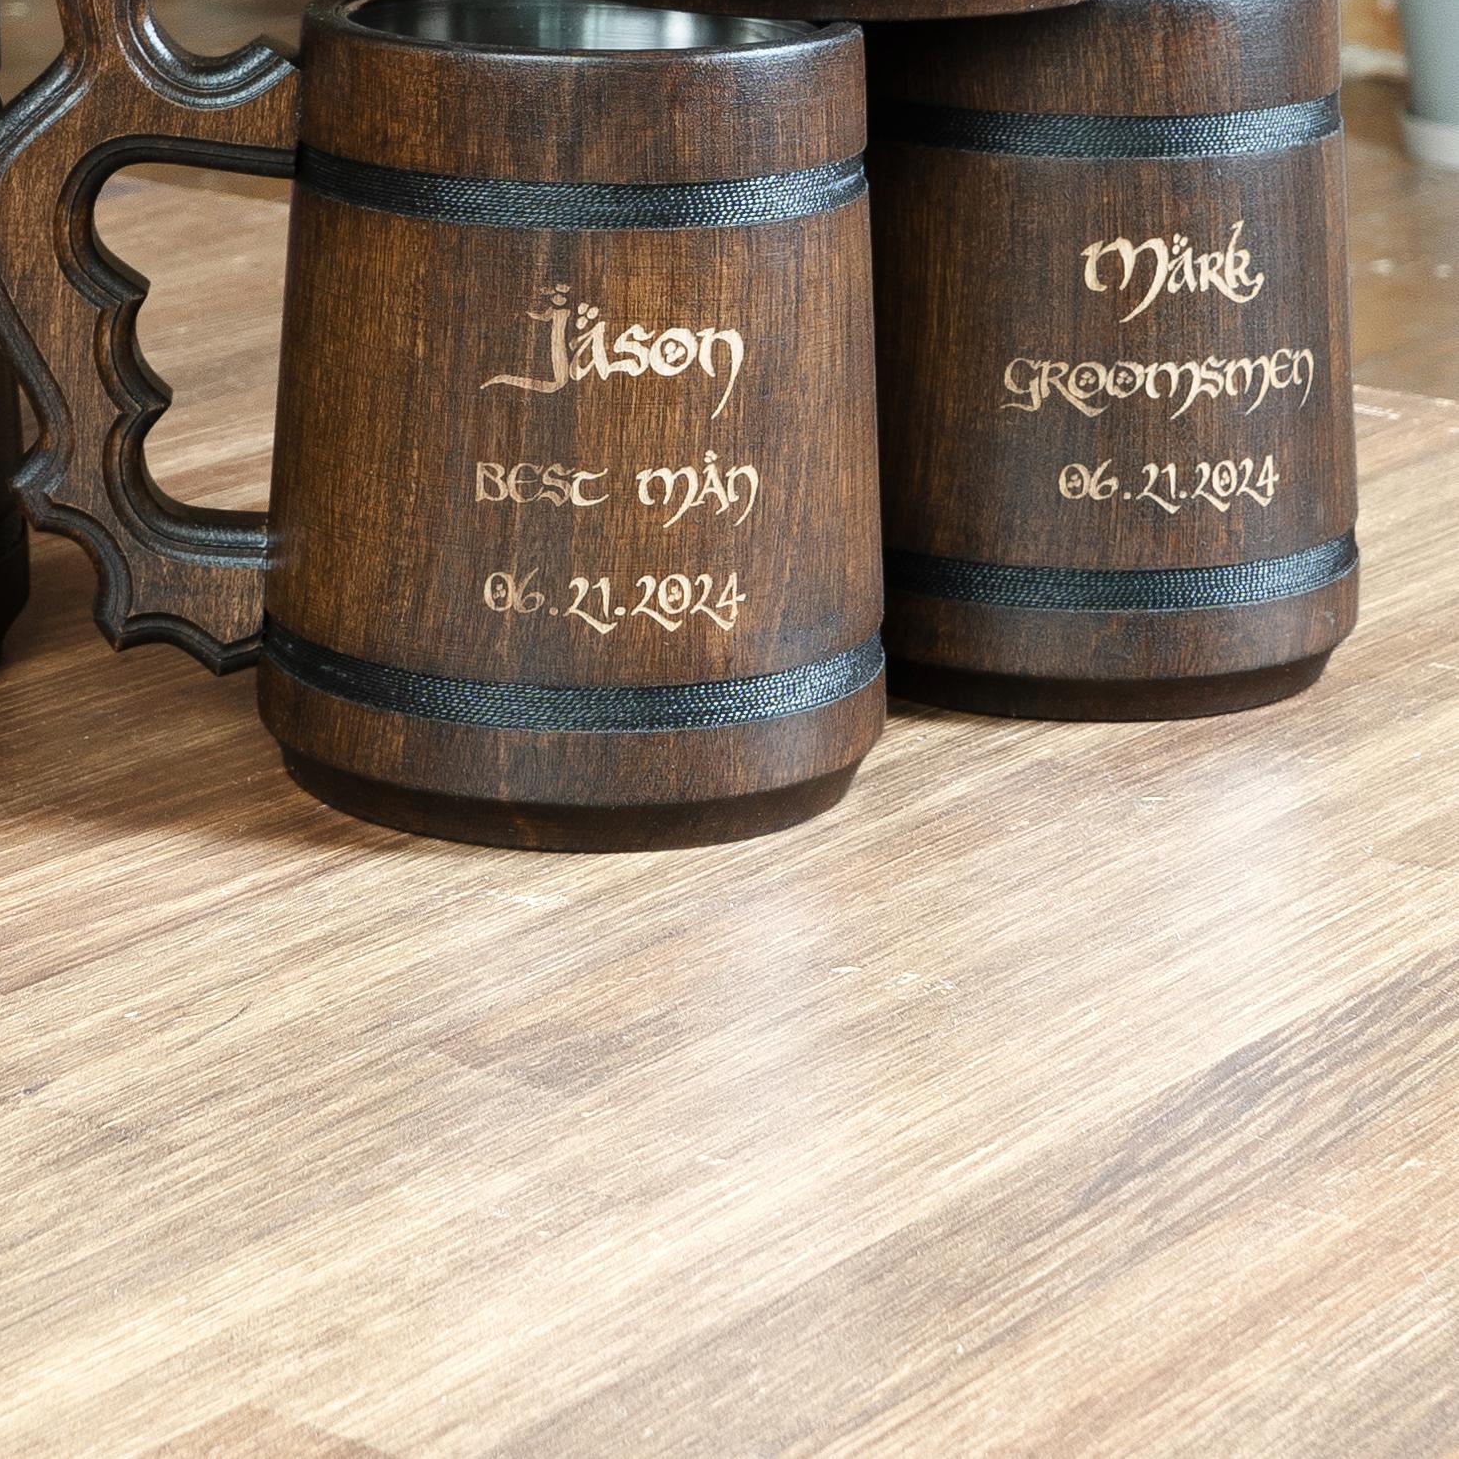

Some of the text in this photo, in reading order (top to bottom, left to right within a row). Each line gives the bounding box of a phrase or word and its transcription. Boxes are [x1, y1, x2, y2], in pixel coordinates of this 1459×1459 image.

[1080, 220, 1265, 324] Mark
[479, 284, 745, 420] Jason
[1058, 454, 1280, 515] 06.21.2024
[483, 567, 747, 634] 06.21.2024
